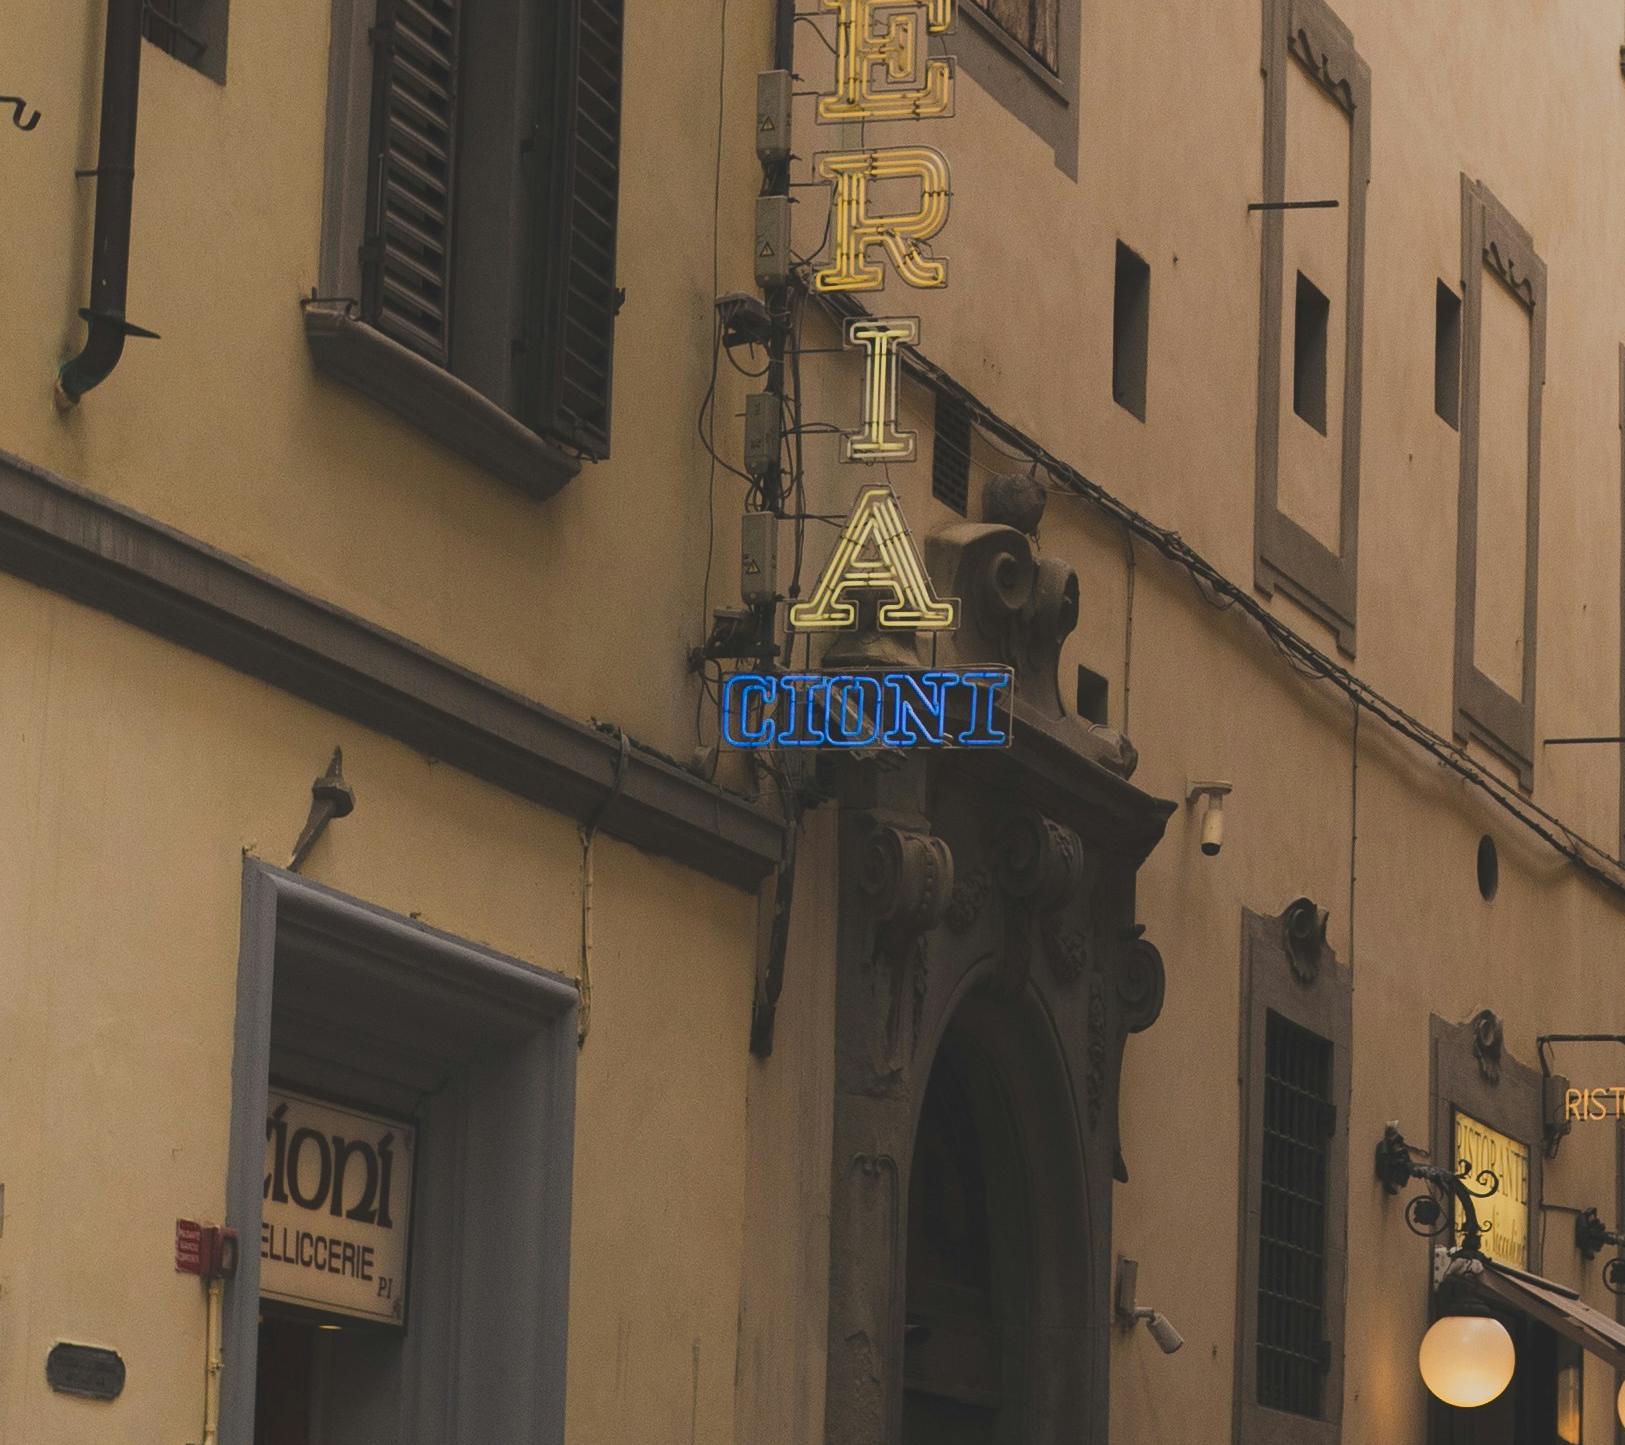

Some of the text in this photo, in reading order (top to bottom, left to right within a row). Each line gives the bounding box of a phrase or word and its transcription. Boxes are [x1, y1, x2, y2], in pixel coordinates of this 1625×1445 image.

[722, 672, 1012, 747] CIONI
[263, 1102, 394, 1229] ioni
[260, 1222, 375, 1282] ELLICCERIE
